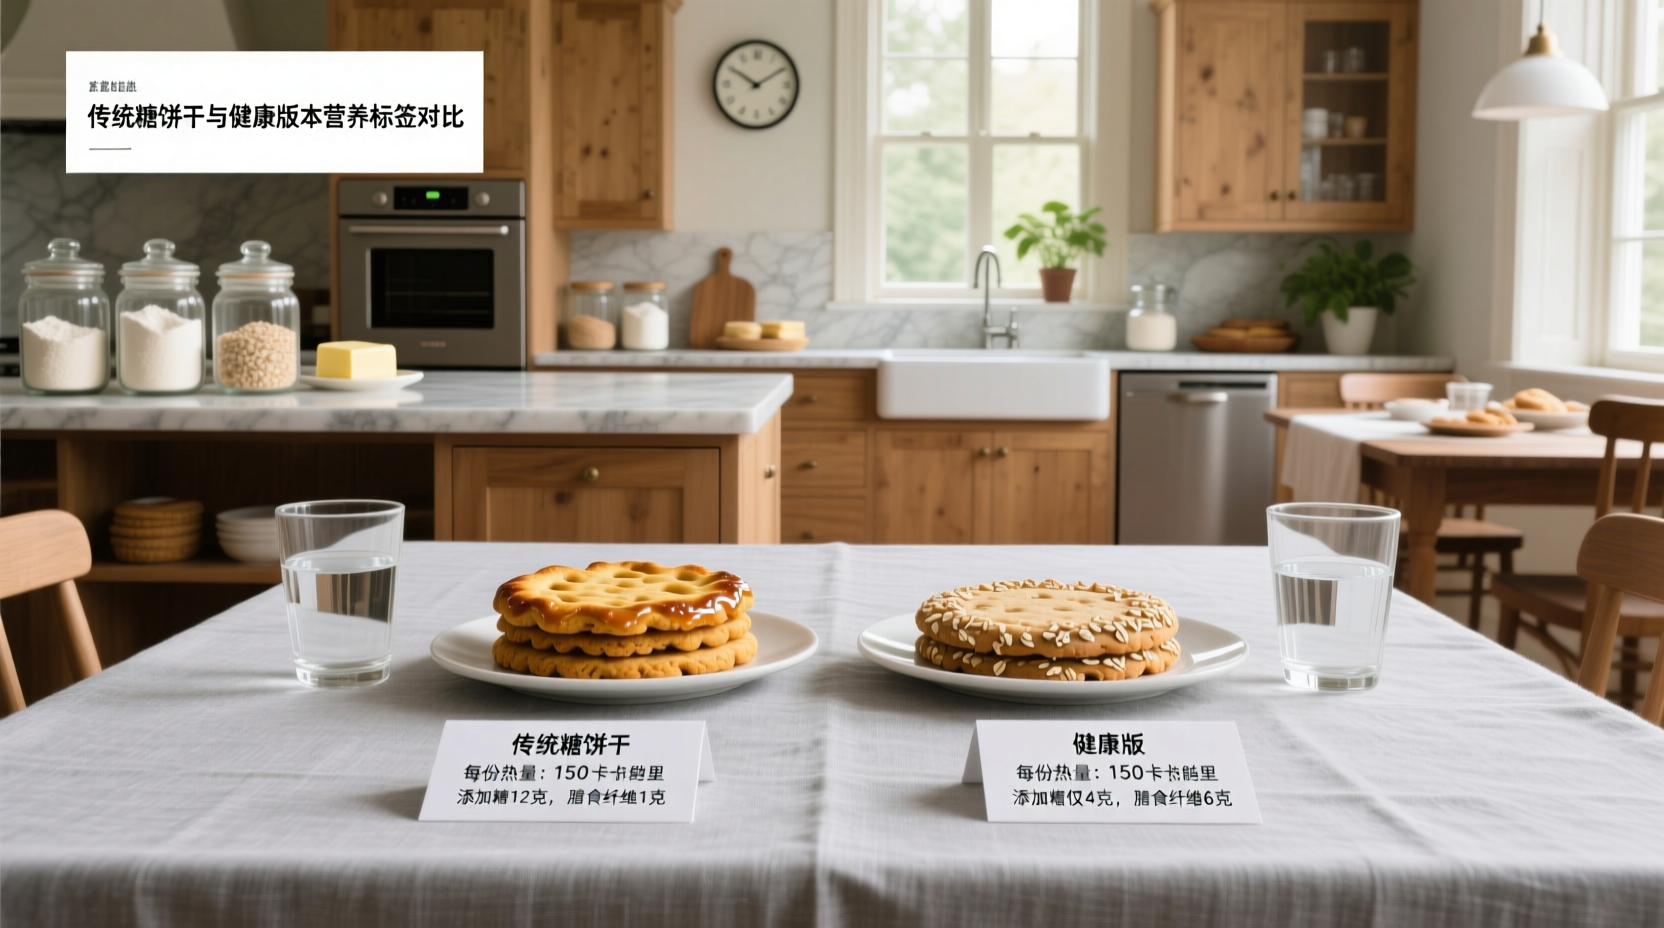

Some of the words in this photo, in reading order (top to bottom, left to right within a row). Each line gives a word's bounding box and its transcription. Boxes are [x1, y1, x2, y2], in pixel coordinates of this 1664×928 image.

[512, 732, 631, 756] 传统糖饼干
[1072, 731, 1146, 756] 健康版
